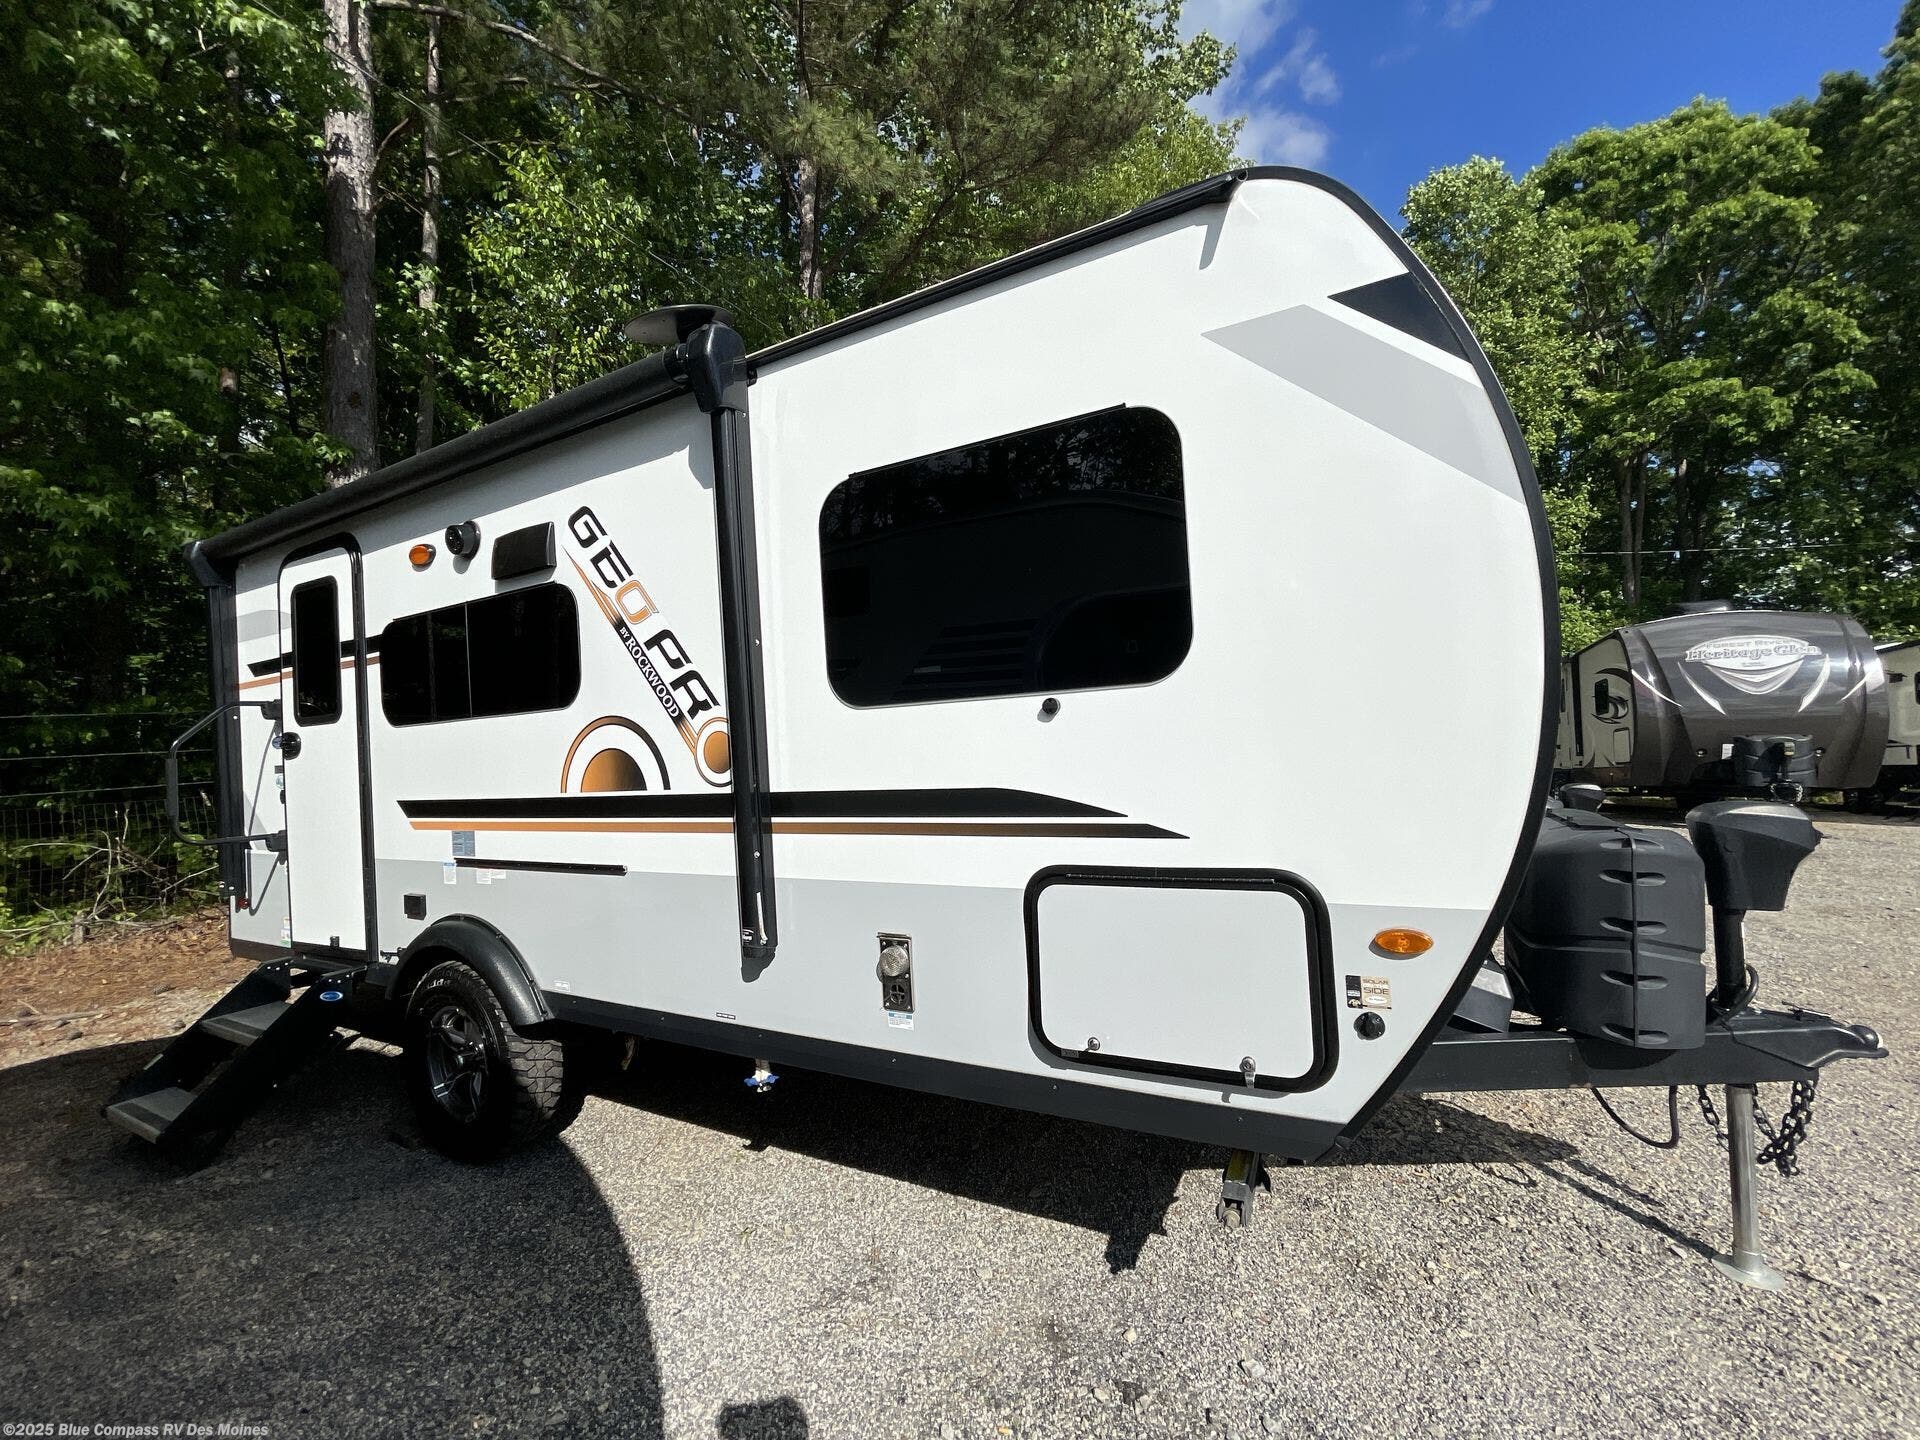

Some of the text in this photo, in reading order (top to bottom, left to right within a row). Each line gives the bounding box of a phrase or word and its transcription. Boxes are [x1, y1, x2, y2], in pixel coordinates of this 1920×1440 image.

[568, 505, 660, 625] GEO
[620, 626, 680, 717] BY ROCKWOOD
[1685, 647, 1773, 662] Heritage
[1363, 986, 1390, 995] SIDE
